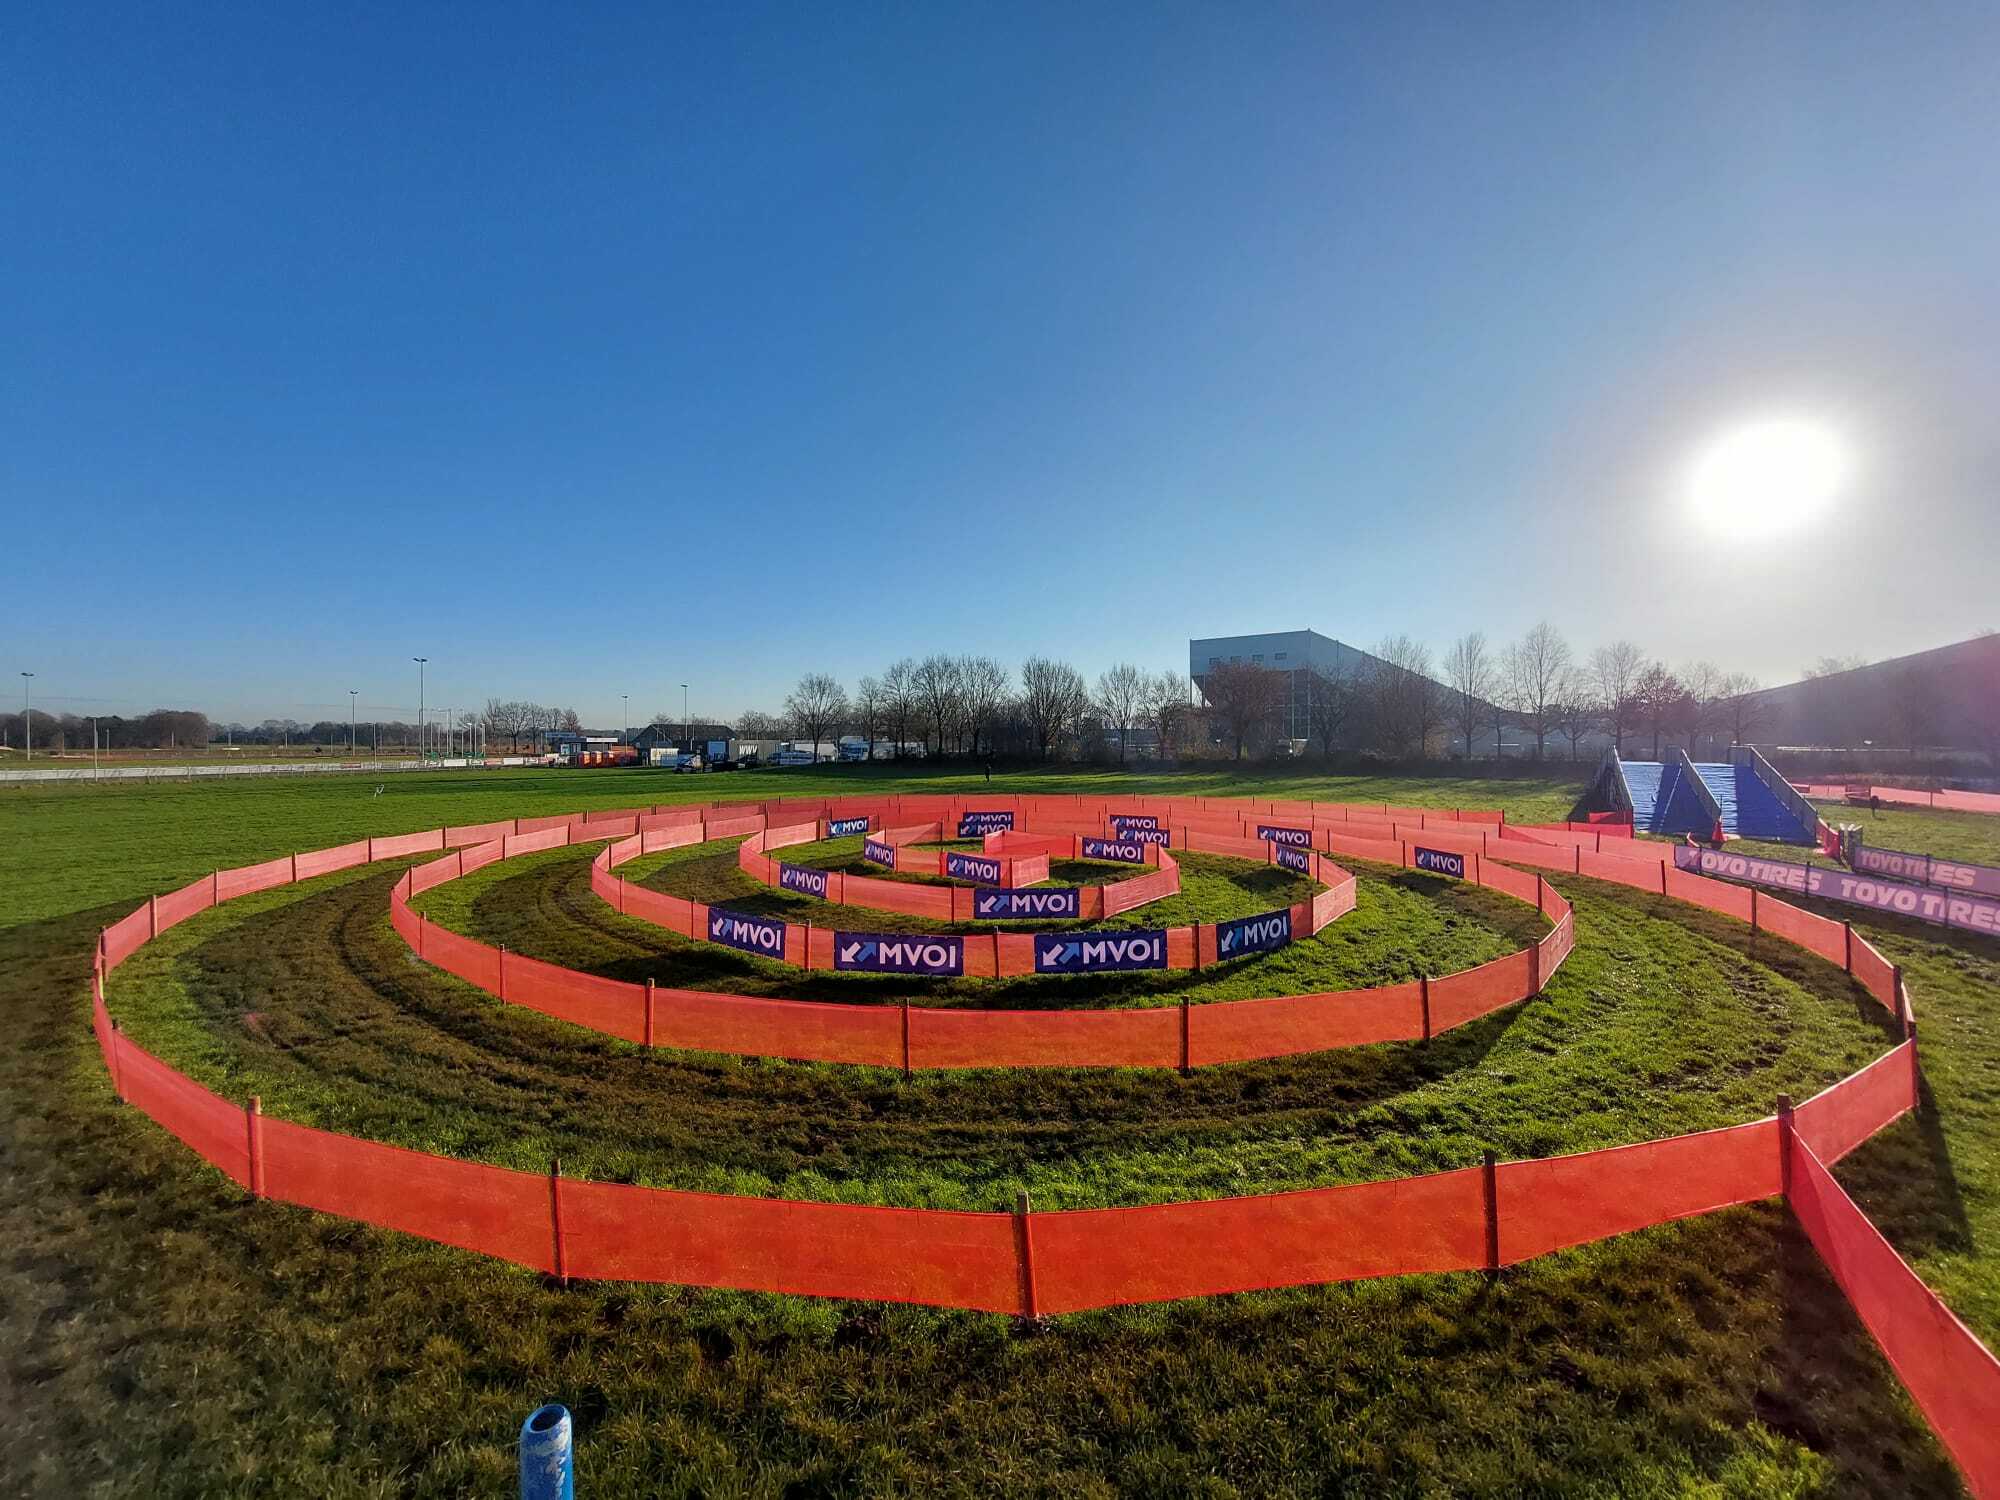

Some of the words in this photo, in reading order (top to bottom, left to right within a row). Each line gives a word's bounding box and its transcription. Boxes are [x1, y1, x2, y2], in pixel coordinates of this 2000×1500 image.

[843, 820, 867, 831] MVOI
[1126, 818, 1156, 829] MVOI
[1134, 830, 1168, 844] MVOI
[1276, 830, 1309, 845] MVOI
[874, 847, 893, 864] MVOI
[1103, 843, 1141, 859] MVOI
[1285, 851, 1308, 870] MVOI
[964, 861, 998, 880] MVOI
[1430, 855, 1461, 873] MVOI
[1861, 851, 1903, 873] TOYO
[796, 871, 825, 892] MVOI
[1750, 862, 1823, 891] TIRES
[1012, 894, 1073, 912] MVOI
[1840, 878, 1917, 911] TOYO
[733, 920, 781, 950] MVOI
[1244, 916, 1288, 946] MVOI
[879, 942, 956, 968] MVOI
[1083, 938, 1160, 964] MVOI
